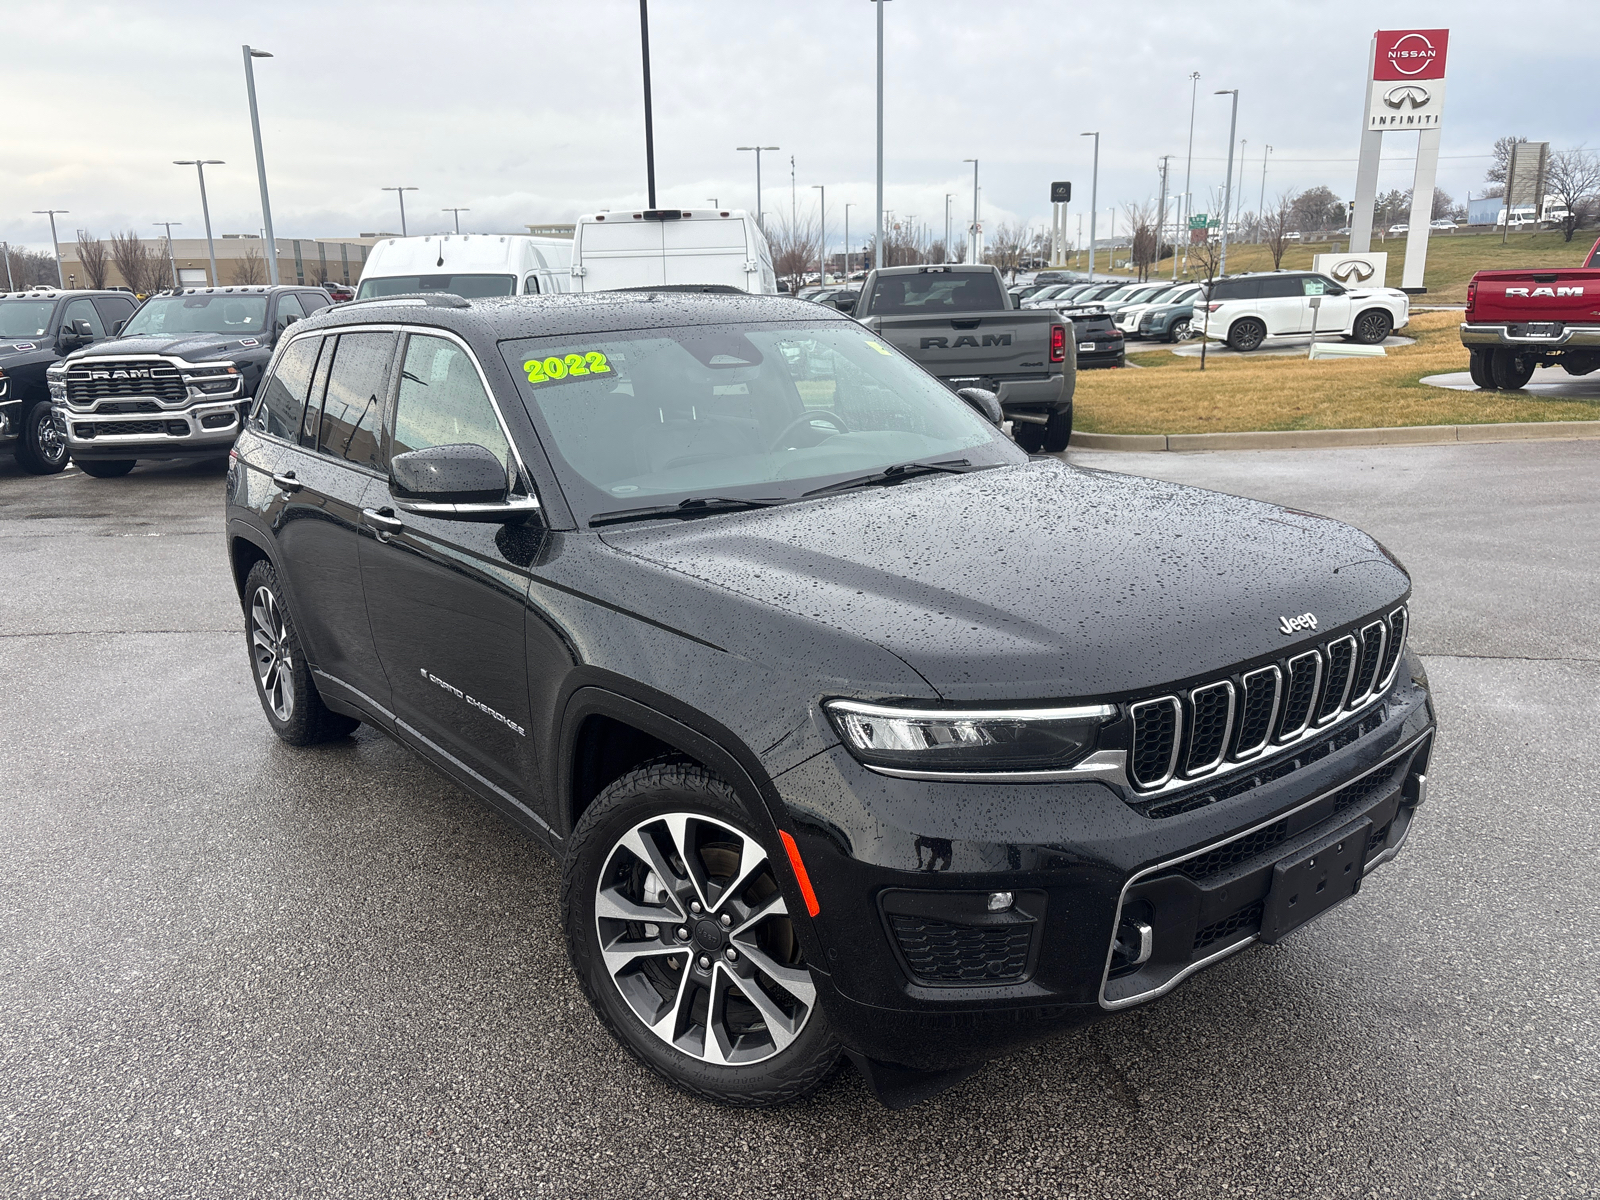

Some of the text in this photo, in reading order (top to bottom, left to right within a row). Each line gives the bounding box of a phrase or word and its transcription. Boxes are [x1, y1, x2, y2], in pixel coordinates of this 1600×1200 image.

[1388, 50, 1436, 58] NISSAN
[1372, 115, 1438, 125] INFINITI
[1505, 287, 1584, 298] RAM
[920, 334, 1012, 349] RAM
[91, 369, 150, 380] RAM
[523, 351, 611, 384] 2022
[1279, 612, 1318, 634] Jeep
[429, 673, 526, 737] GRAND CHEROKEE
[573, 857, 591, 959] COOPER
